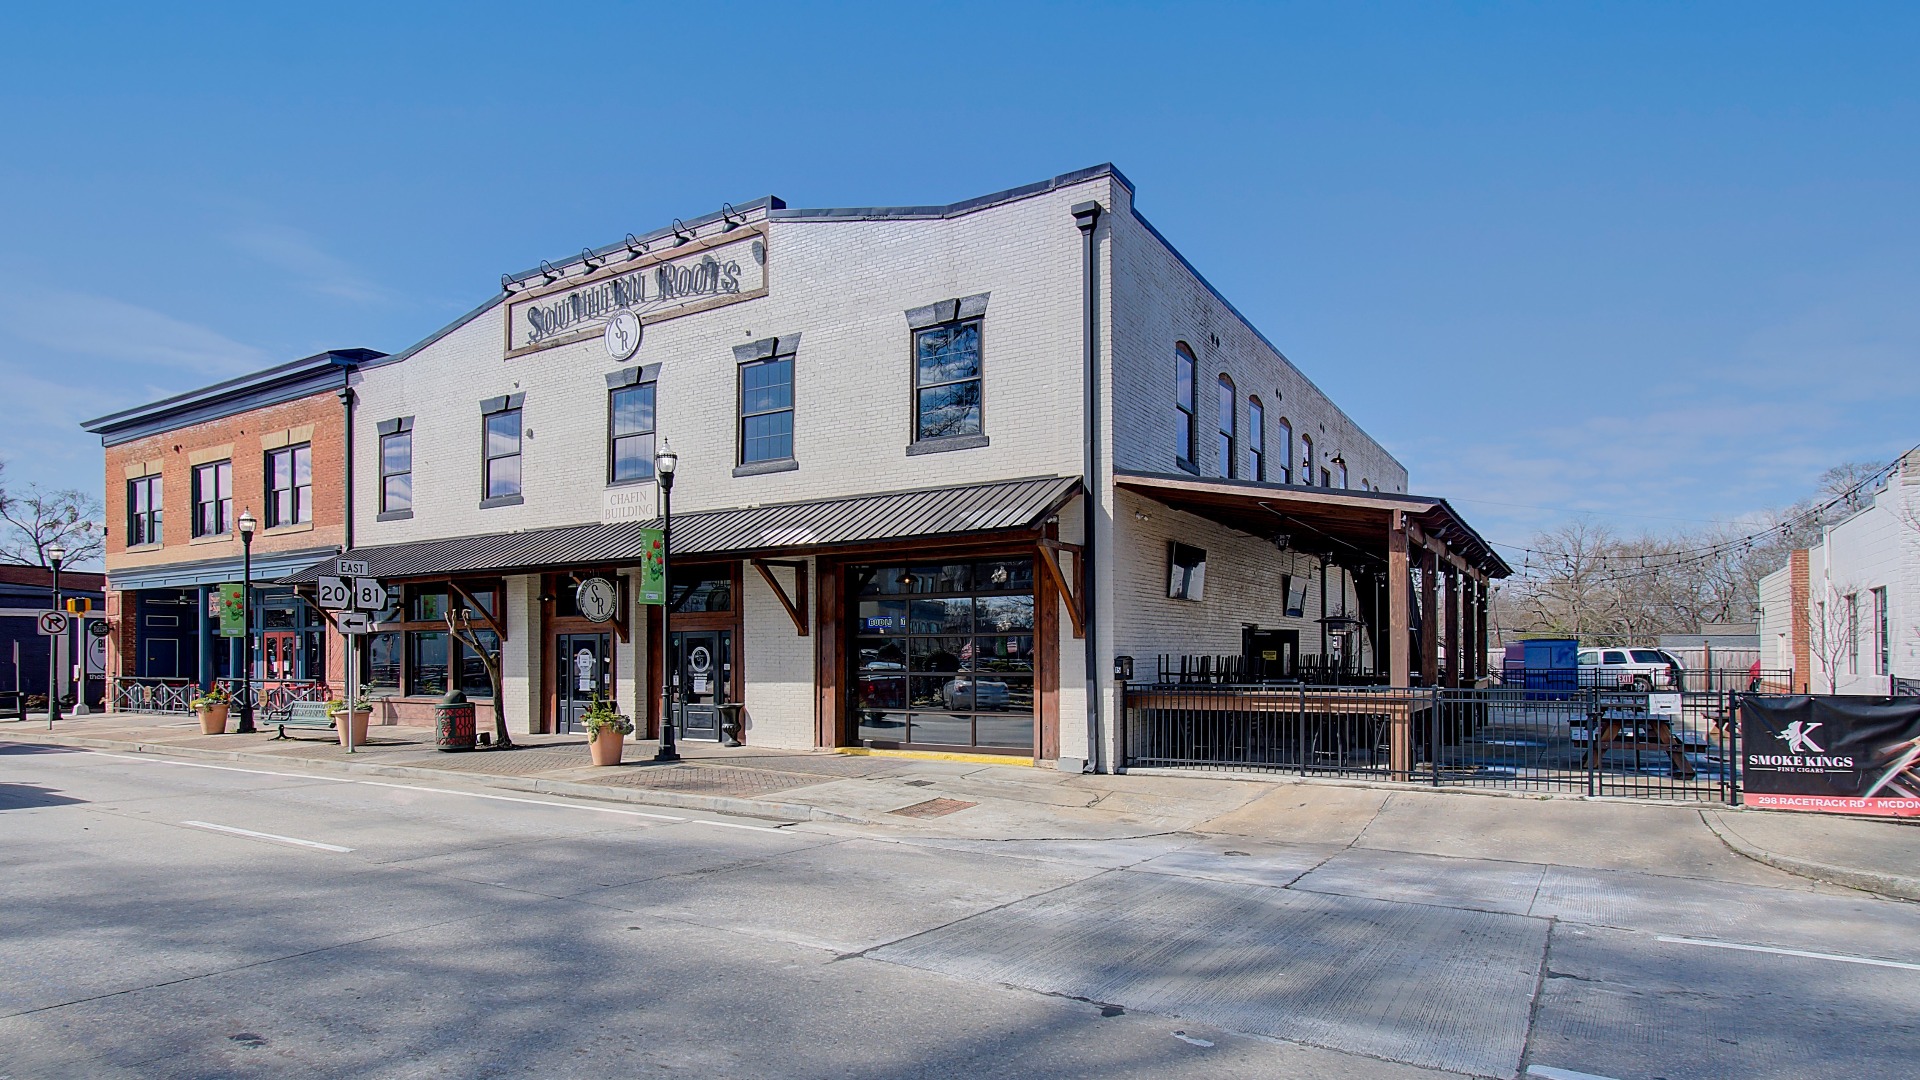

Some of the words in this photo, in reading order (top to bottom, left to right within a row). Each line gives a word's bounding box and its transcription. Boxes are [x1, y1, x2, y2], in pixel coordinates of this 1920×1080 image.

[527, 271, 646, 344] SOUTHERN
[658, 259, 742, 300] ROOTS
[610, 490, 648, 505] CHAFIN
[605, 504, 654, 520] BUILDING
[640, 532, 648, 586] WELCOME
[341, 561, 364, 574] EAST
[321, 586, 345, 601] 20
[362, 587, 379, 603] 81
[1617, 674, 1632, 683] EXIT
[1749, 754, 1802, 766] SMOKE
[1805, 755, 1854, 768] KINGS
[1758, 796, 1777, 805] 298
[1779, 797, 1848, 807] RACETRACK
[1849, 799, 1866, 808] RD
